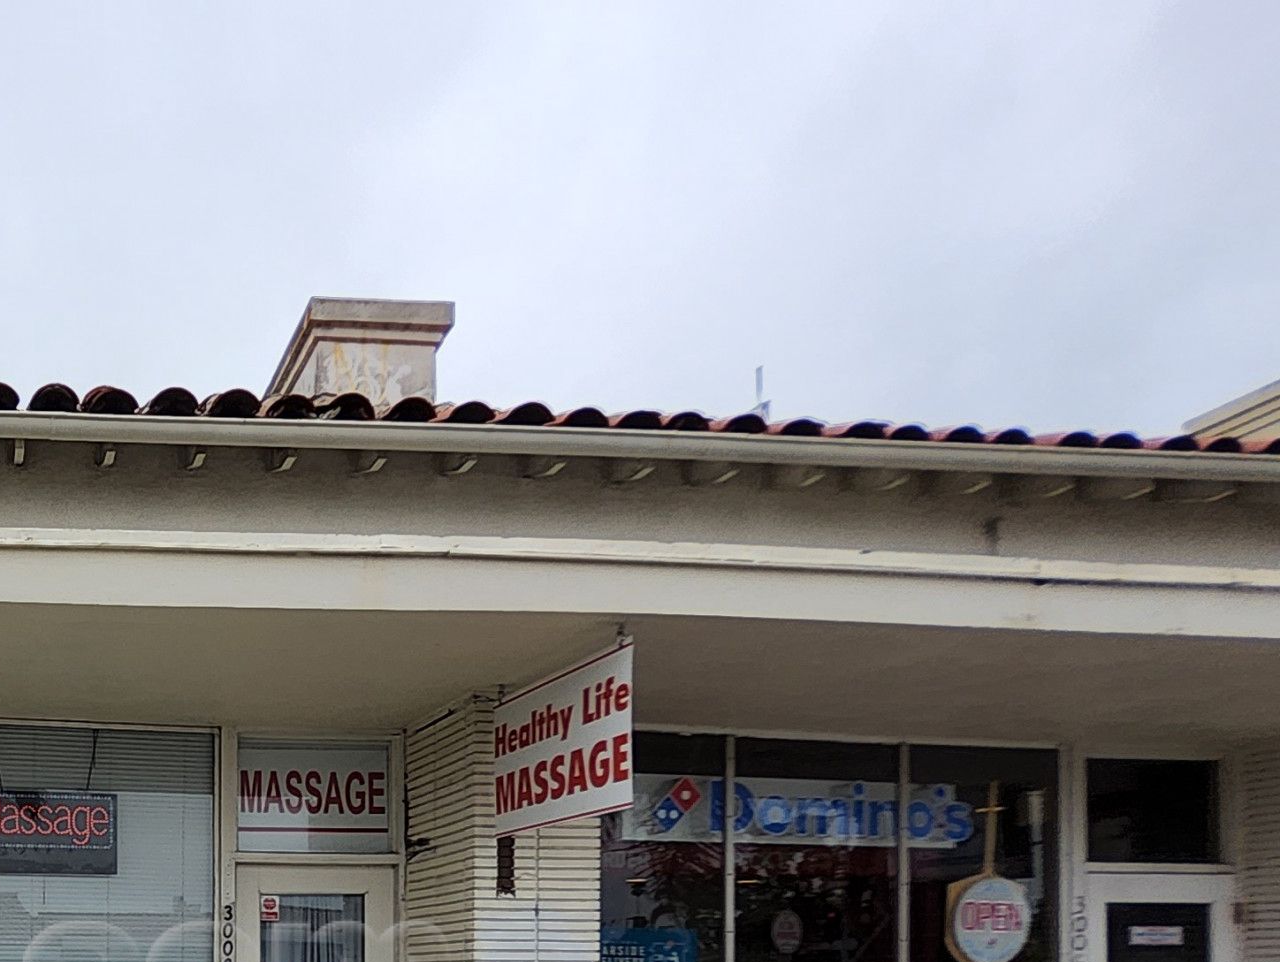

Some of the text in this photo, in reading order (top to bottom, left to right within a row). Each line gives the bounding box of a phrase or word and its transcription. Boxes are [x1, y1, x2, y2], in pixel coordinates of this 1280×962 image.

[495, 676, 630, 758] Healthy Life
[240, 770, 386, 815] MASSAGE
[495, 733, 630, 816] MASSAGE
[708, 780, 974, 842] Domino's
[962, 901, 1022, 931] OPEN
